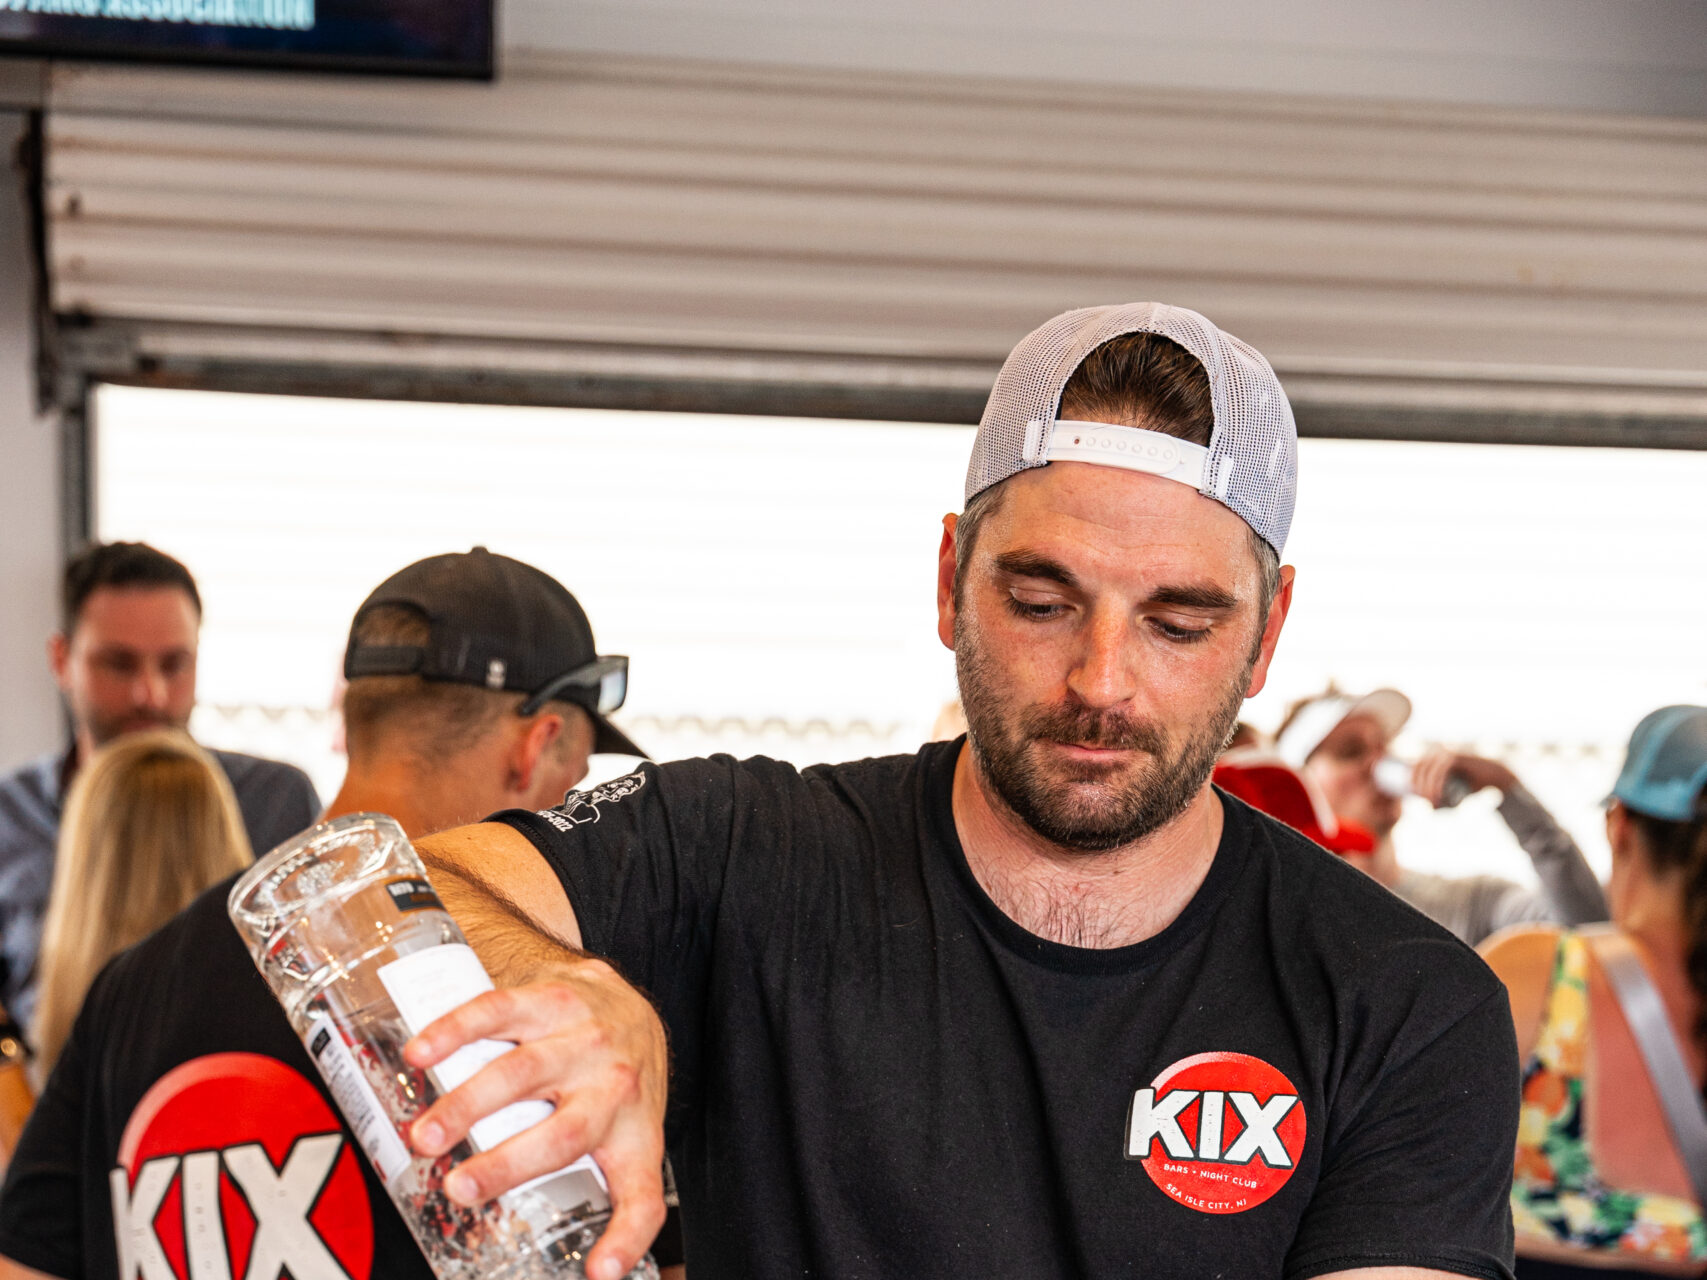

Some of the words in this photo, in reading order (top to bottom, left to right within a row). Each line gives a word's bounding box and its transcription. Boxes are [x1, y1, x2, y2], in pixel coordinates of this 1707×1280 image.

[1127, 1087, 1299, 1168] KIX
[1163, 1163, 1189, 1175] BARS
[1200, 1170, 1229, 1183] NIGHT
[1232, 1176, 1258, 1189] CLUB
[1166, 1182, 1182, 1199] SEA
[1184, 1194, 1206, 1209] ISLE
